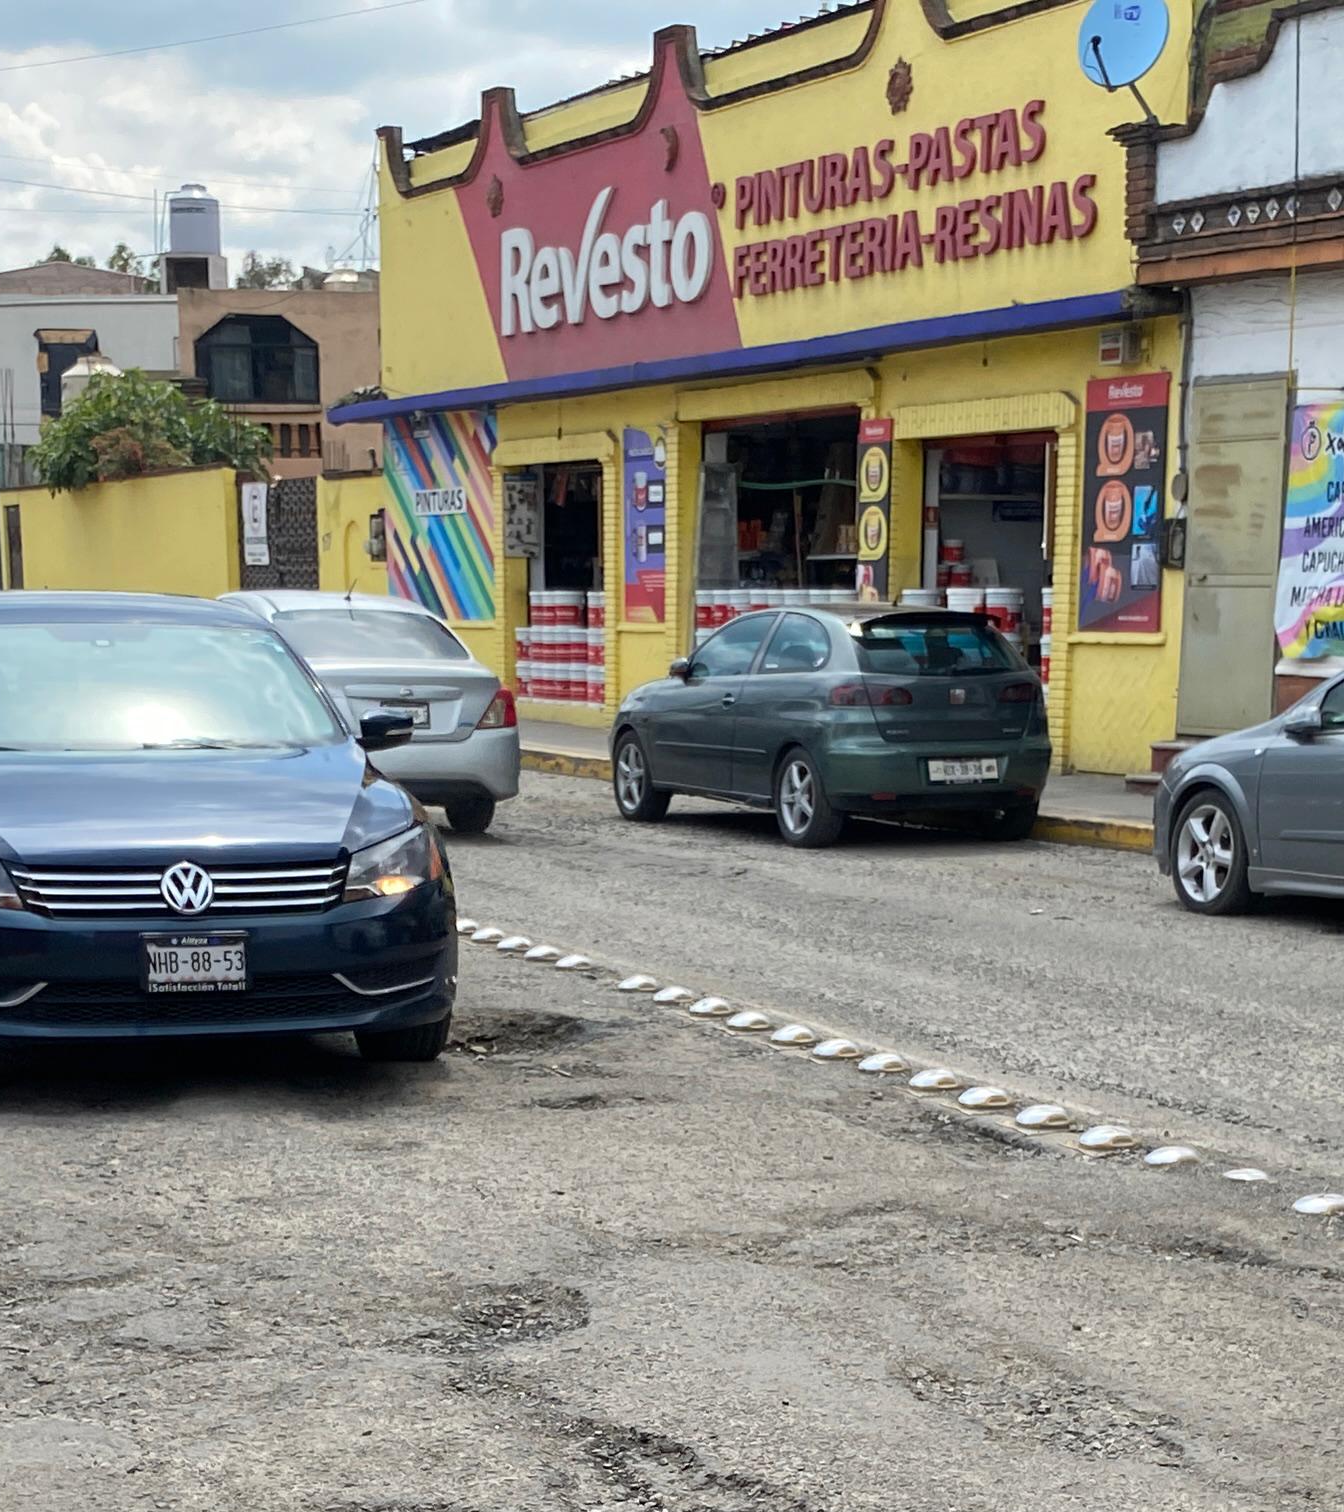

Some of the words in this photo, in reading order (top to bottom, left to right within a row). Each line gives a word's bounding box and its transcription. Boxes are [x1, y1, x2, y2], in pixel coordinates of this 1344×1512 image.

[735, 100, 1045, 229] PINTURAS-PASTAS
[500, 185, 714, 337] Revesto
[733, 174, 1097, 299] FERRETERIA-RESINAS
[416, 489, 464, 513] PINTURAS
[147, 950, 244, 975] NHB-88-53
